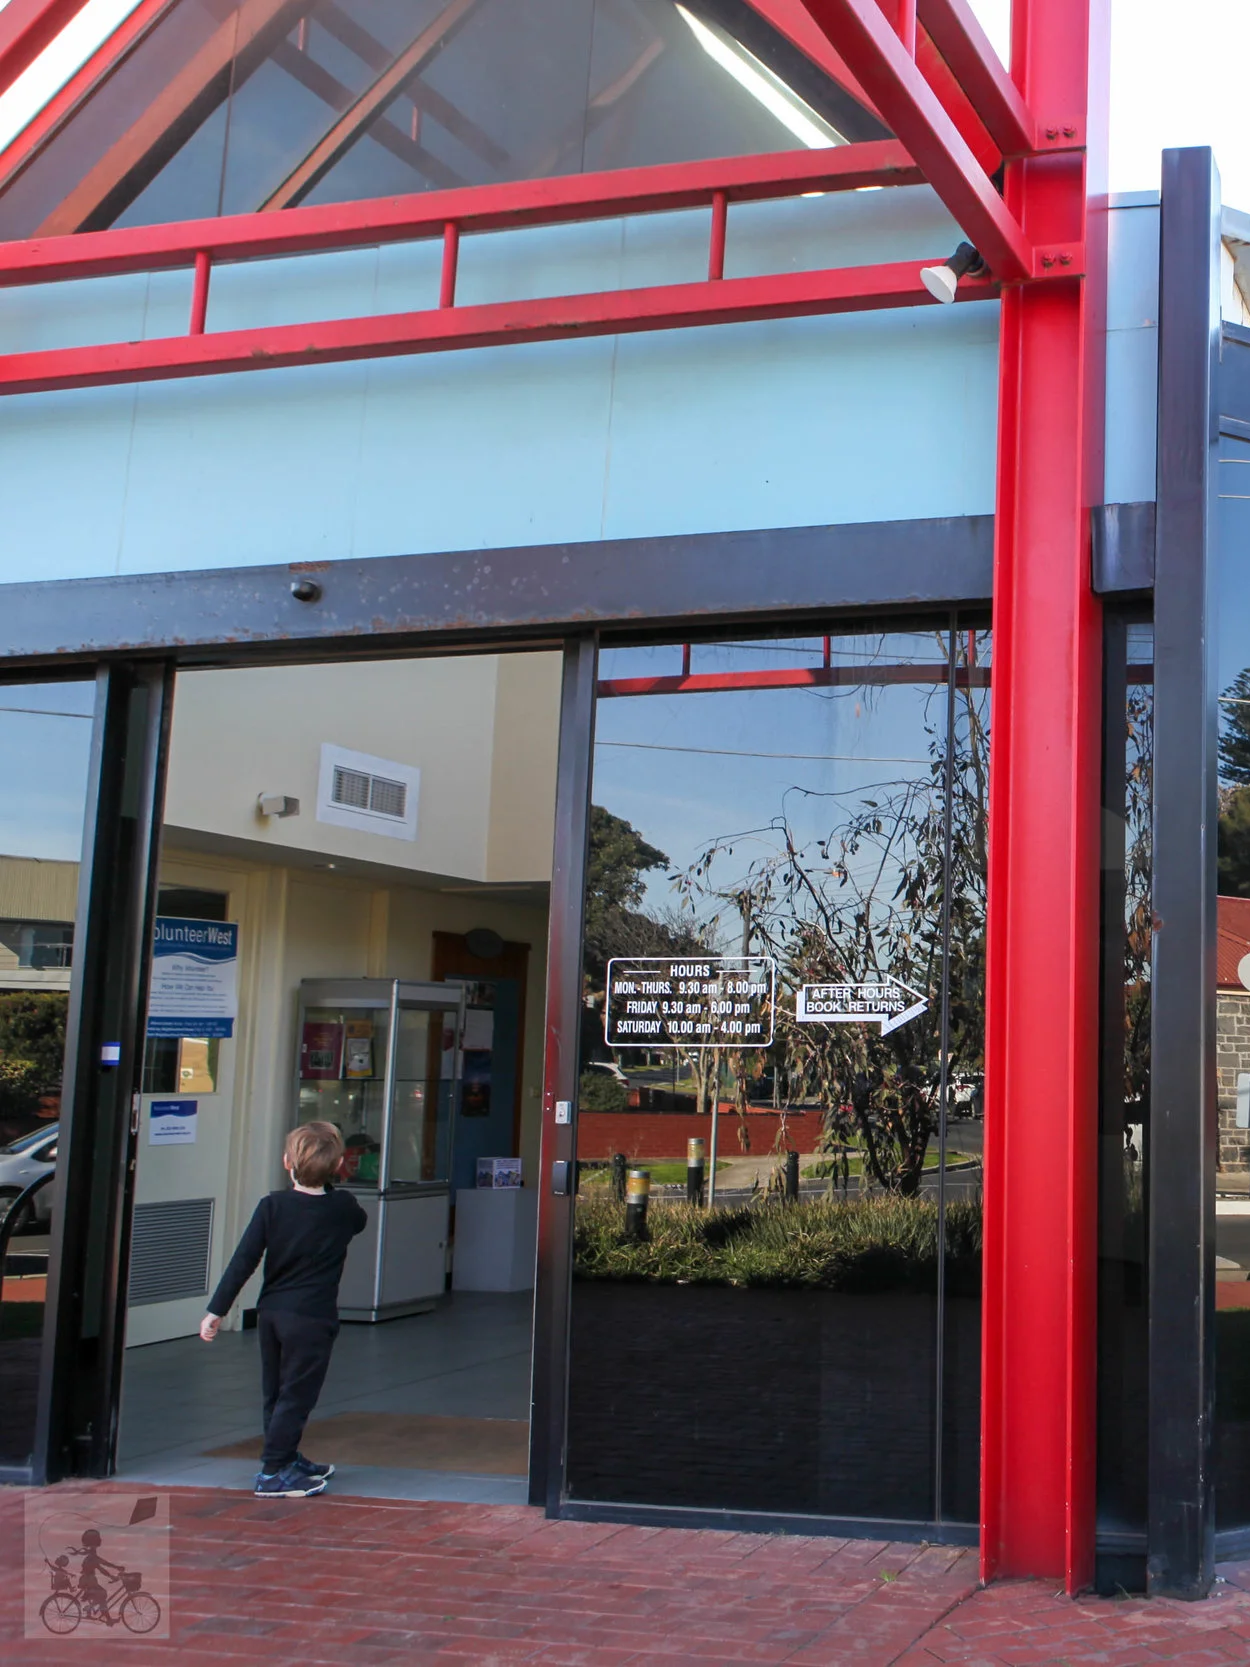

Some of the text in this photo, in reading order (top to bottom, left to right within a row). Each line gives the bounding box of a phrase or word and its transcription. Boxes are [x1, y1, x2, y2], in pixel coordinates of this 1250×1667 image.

[154, 923, 233, 945] olunteerWest
[670, 965, 710, 976] HOURS
[679, 981, 700, 994] 9.30
[702, 983, 718, 994] am
[727, 981, 749, 994] 8.00
[750, 983, 767, 996] pm
[812, 988, 901, 999] AFTER HOURS
[626, 1001, 658, 1014] FRIDAY
[662, 1001, 684, 1014] 9.30
[686, 1003, 701, 1014] am
[711, 1001, 732, 1014] 6.00
[734, 1003, 750, 1016] pm
[806, 1001, 906, 1012] BOOK RETURNS
[617, 1021, 662, 1034] SATURDAY
[667, 1021, 693, 1034] 10.00
[695, 1023, 712, 1034] am
[721, 1021, 742, 1034] 4.00
[745, 1023, 761, 1036] pm
